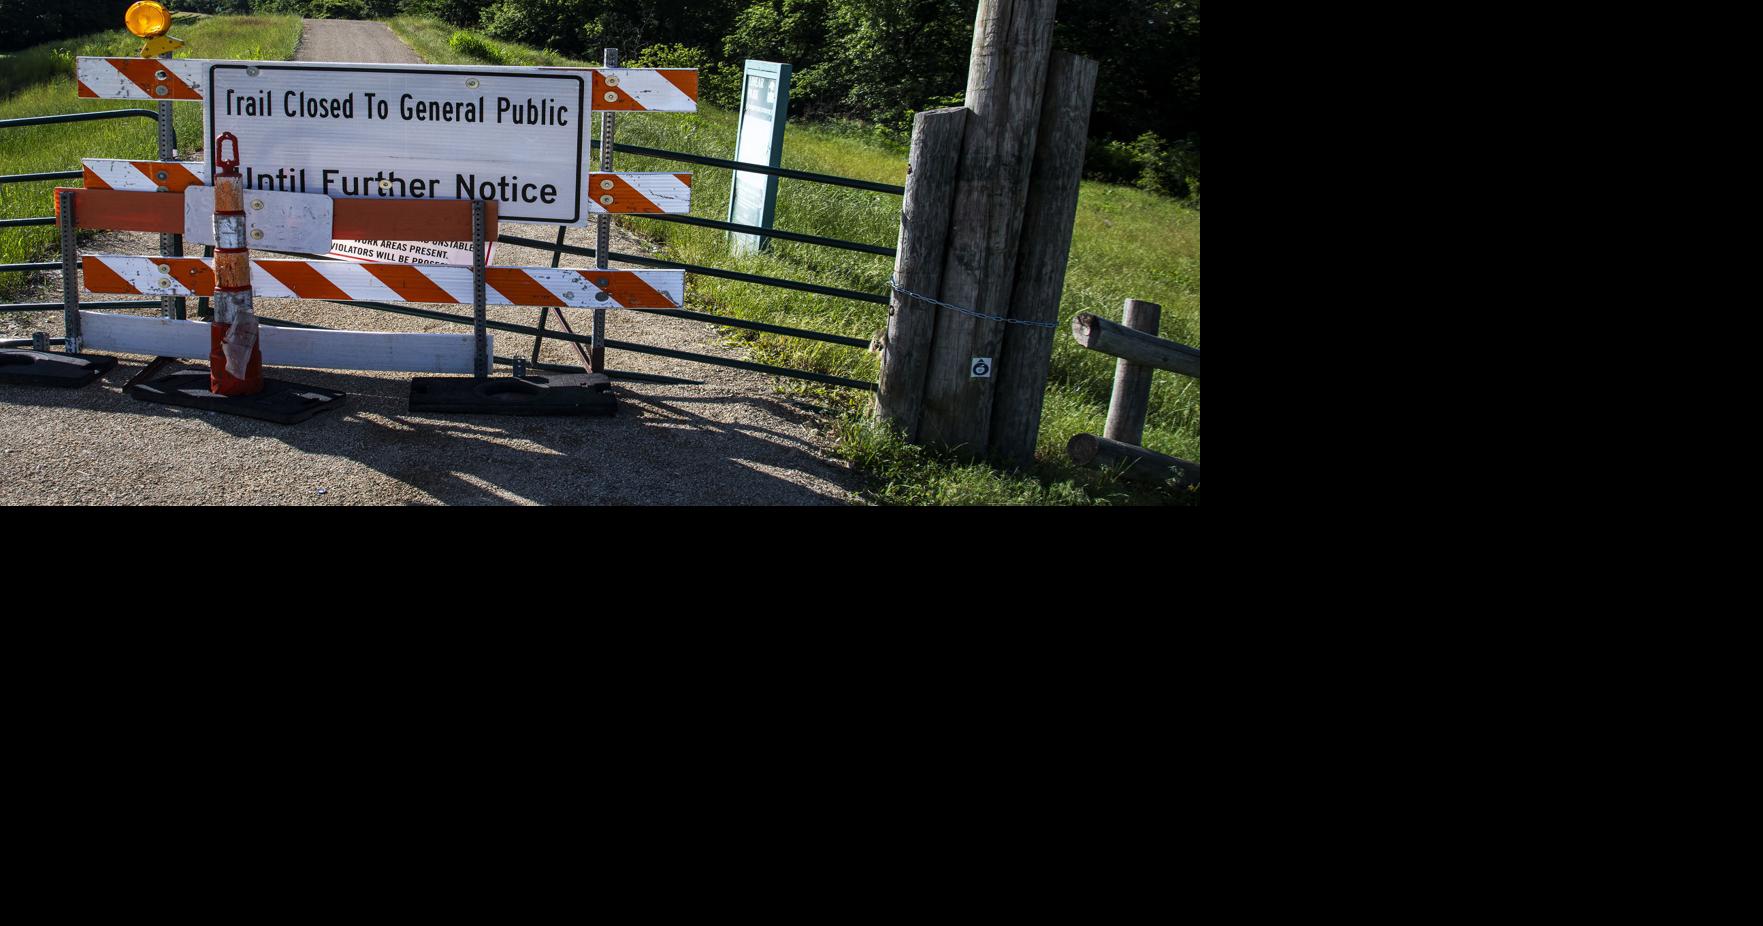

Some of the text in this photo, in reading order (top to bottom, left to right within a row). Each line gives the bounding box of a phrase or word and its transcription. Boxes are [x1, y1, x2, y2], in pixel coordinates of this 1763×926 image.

[284, 90, 354, 119] Closed
[364, 92, 389, 120] To
[400, 93, 484, 123] General
[497, 96, 568, 127] Public
[322, 169, 440, 198] Further
[456, 173, 557, 204] Notice
[331, 242, 374, 258] VIOLATORS
[376, 250, 396, 262] WILL
[398, 254, 410, 264] BE
[354, 239, 379, 247] ORK
[380, 240, 408, 252] AREAS
[409, 244, 449, 260] PRESENT.
